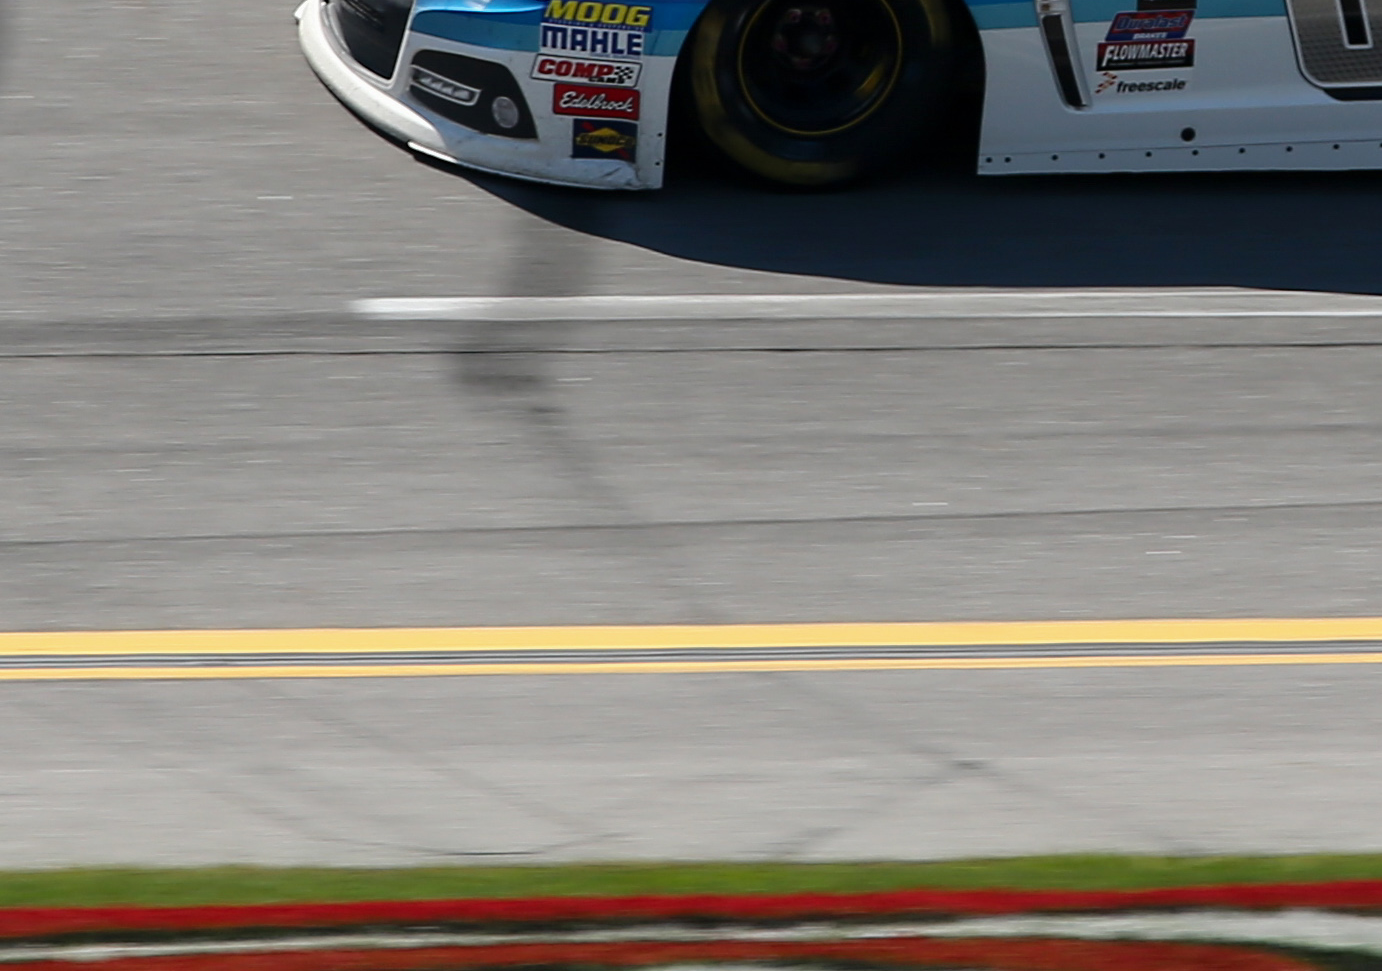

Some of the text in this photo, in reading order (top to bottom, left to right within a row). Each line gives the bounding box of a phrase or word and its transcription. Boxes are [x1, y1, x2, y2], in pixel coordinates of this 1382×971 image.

[544, 0, 652, 26] MOOG
[1115, 15, 1187, 30] Duralast
[542, 25, 642, 55] MAHLE
[1102, 43, 1188, 67] FLOWMASTER
[537, 59, 614, 78] COMP
[1117, 79, 1187, 93] freescale
[559, 91, 634, 112] Edelbrock
